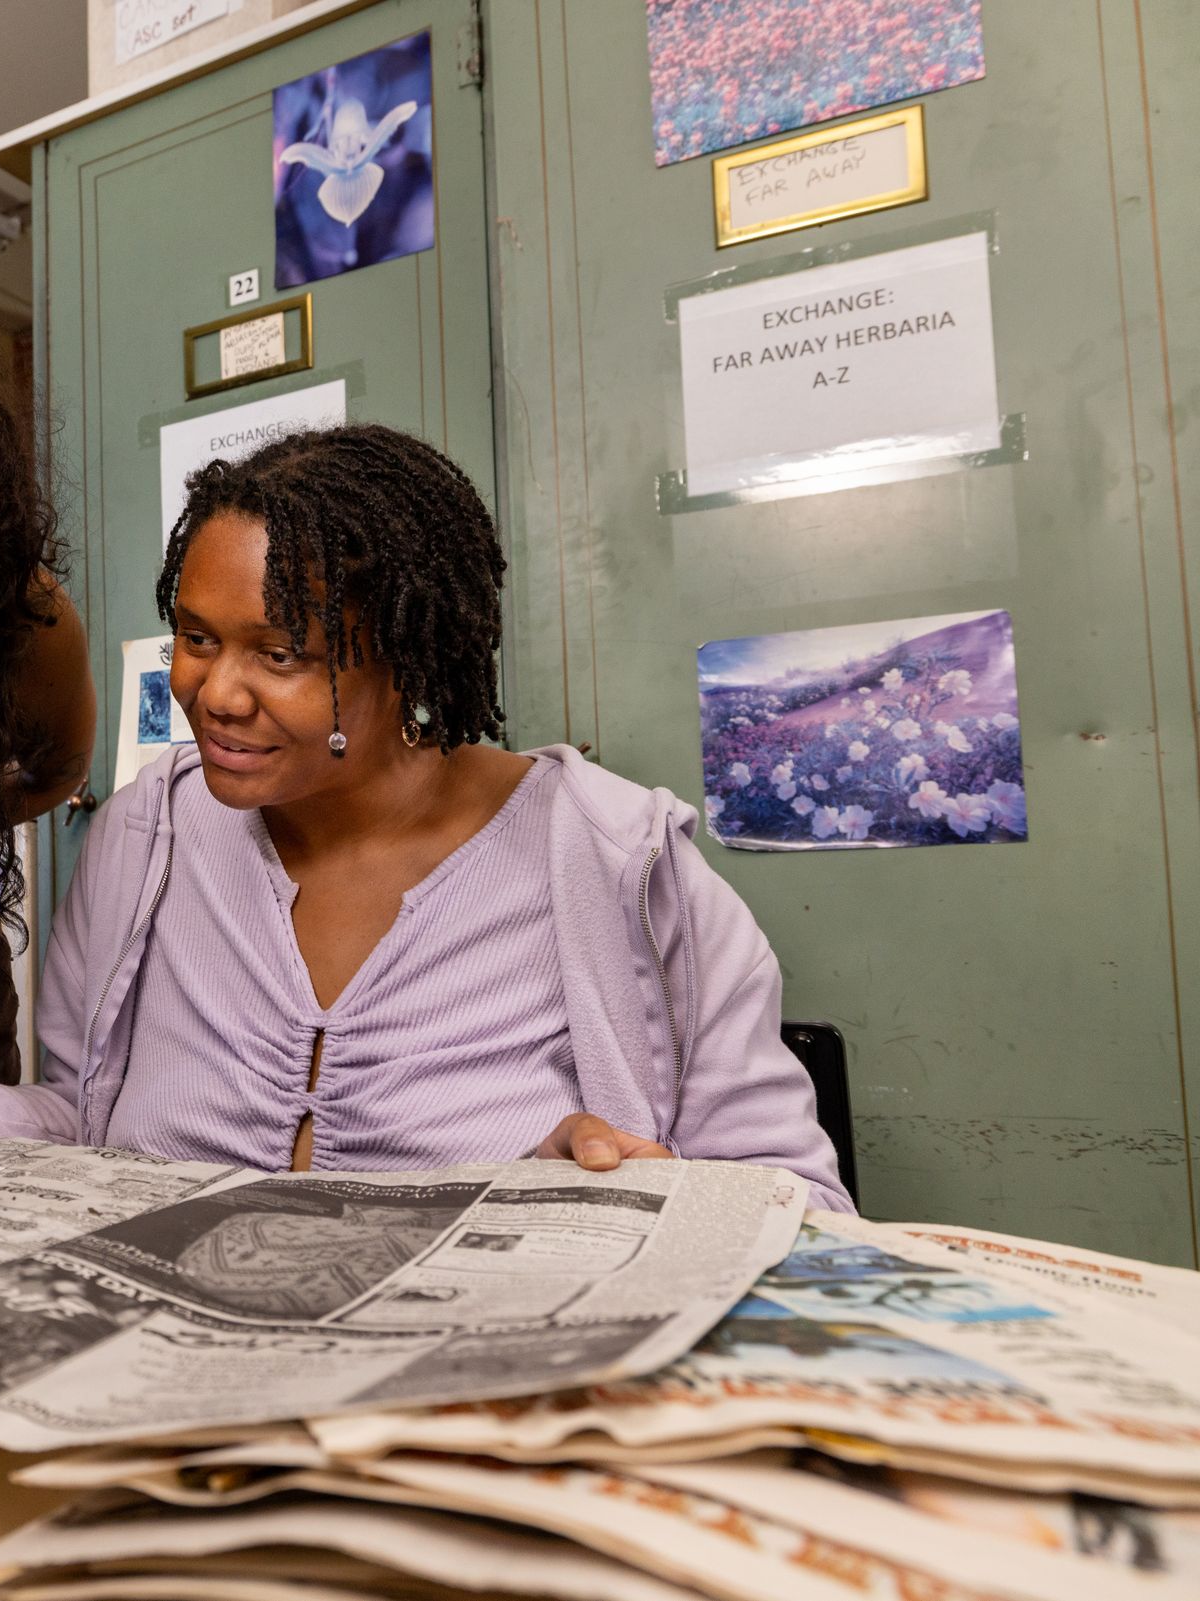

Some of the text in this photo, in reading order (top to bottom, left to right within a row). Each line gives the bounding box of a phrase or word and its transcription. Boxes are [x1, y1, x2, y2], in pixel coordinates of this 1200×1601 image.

[737, 139, 860, 186] EXCHANGE
[745, 149, 866, 205] FAR AWAY
[234, 277, 253, 296] 22
[763, 288, 895, 329] EXCHANGE:
[712, 311, 956, 373] FAR AWAY HERBARIA
[812, 366, 851, 389] A-Z
